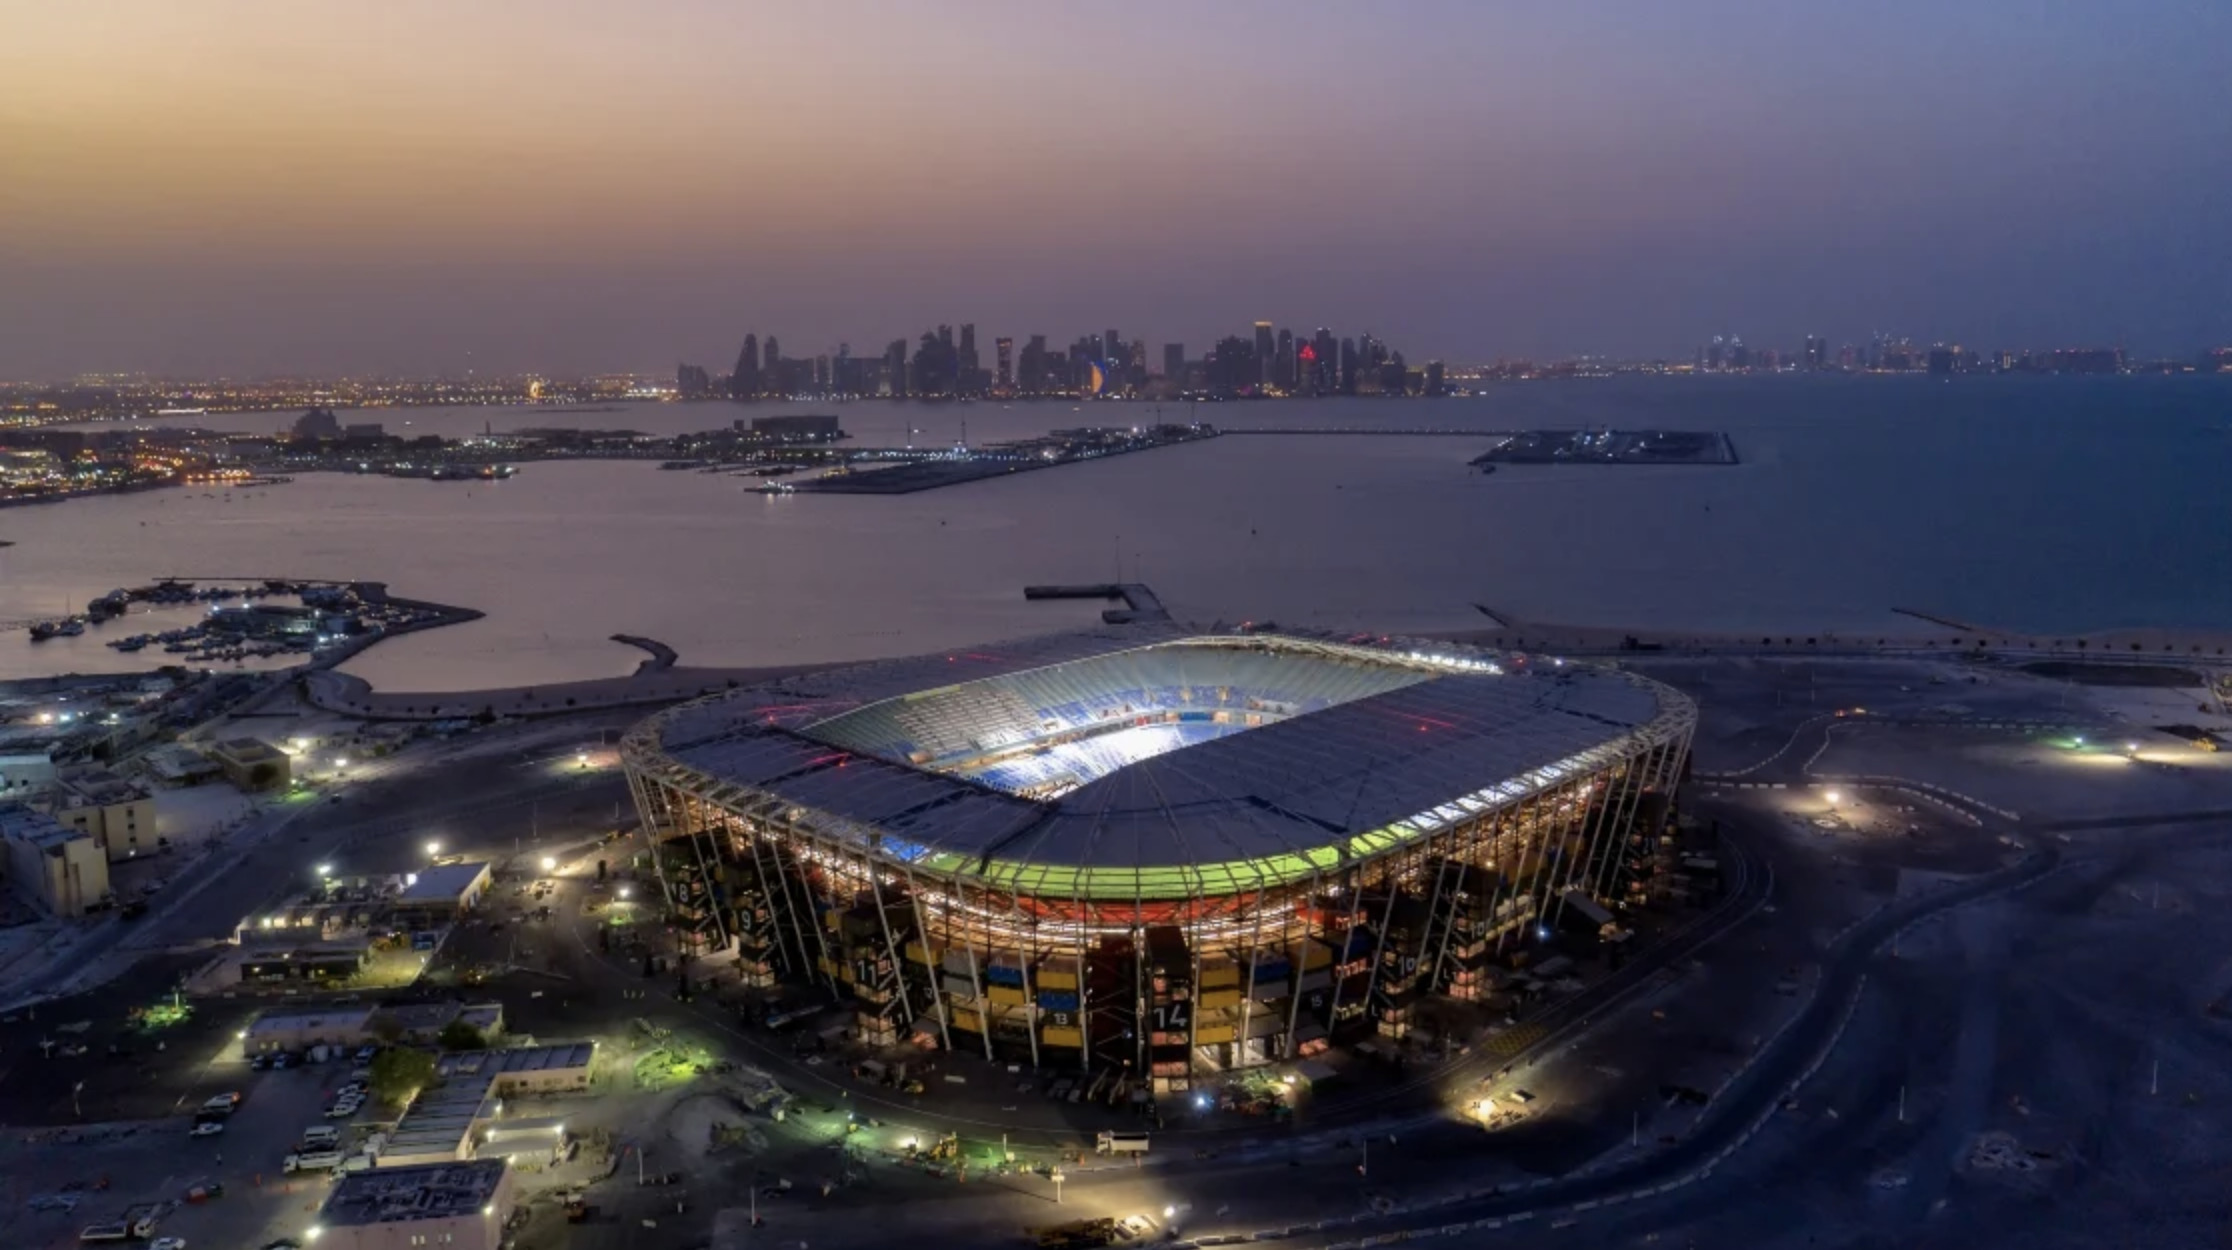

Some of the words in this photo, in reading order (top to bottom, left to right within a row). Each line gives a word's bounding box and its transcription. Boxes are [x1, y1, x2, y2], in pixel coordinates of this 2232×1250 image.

[857, 959, 877, 988] 11
[1053, 1012, 1069, 1026] 13
[1153, 1003, 1188, 1030] 14
